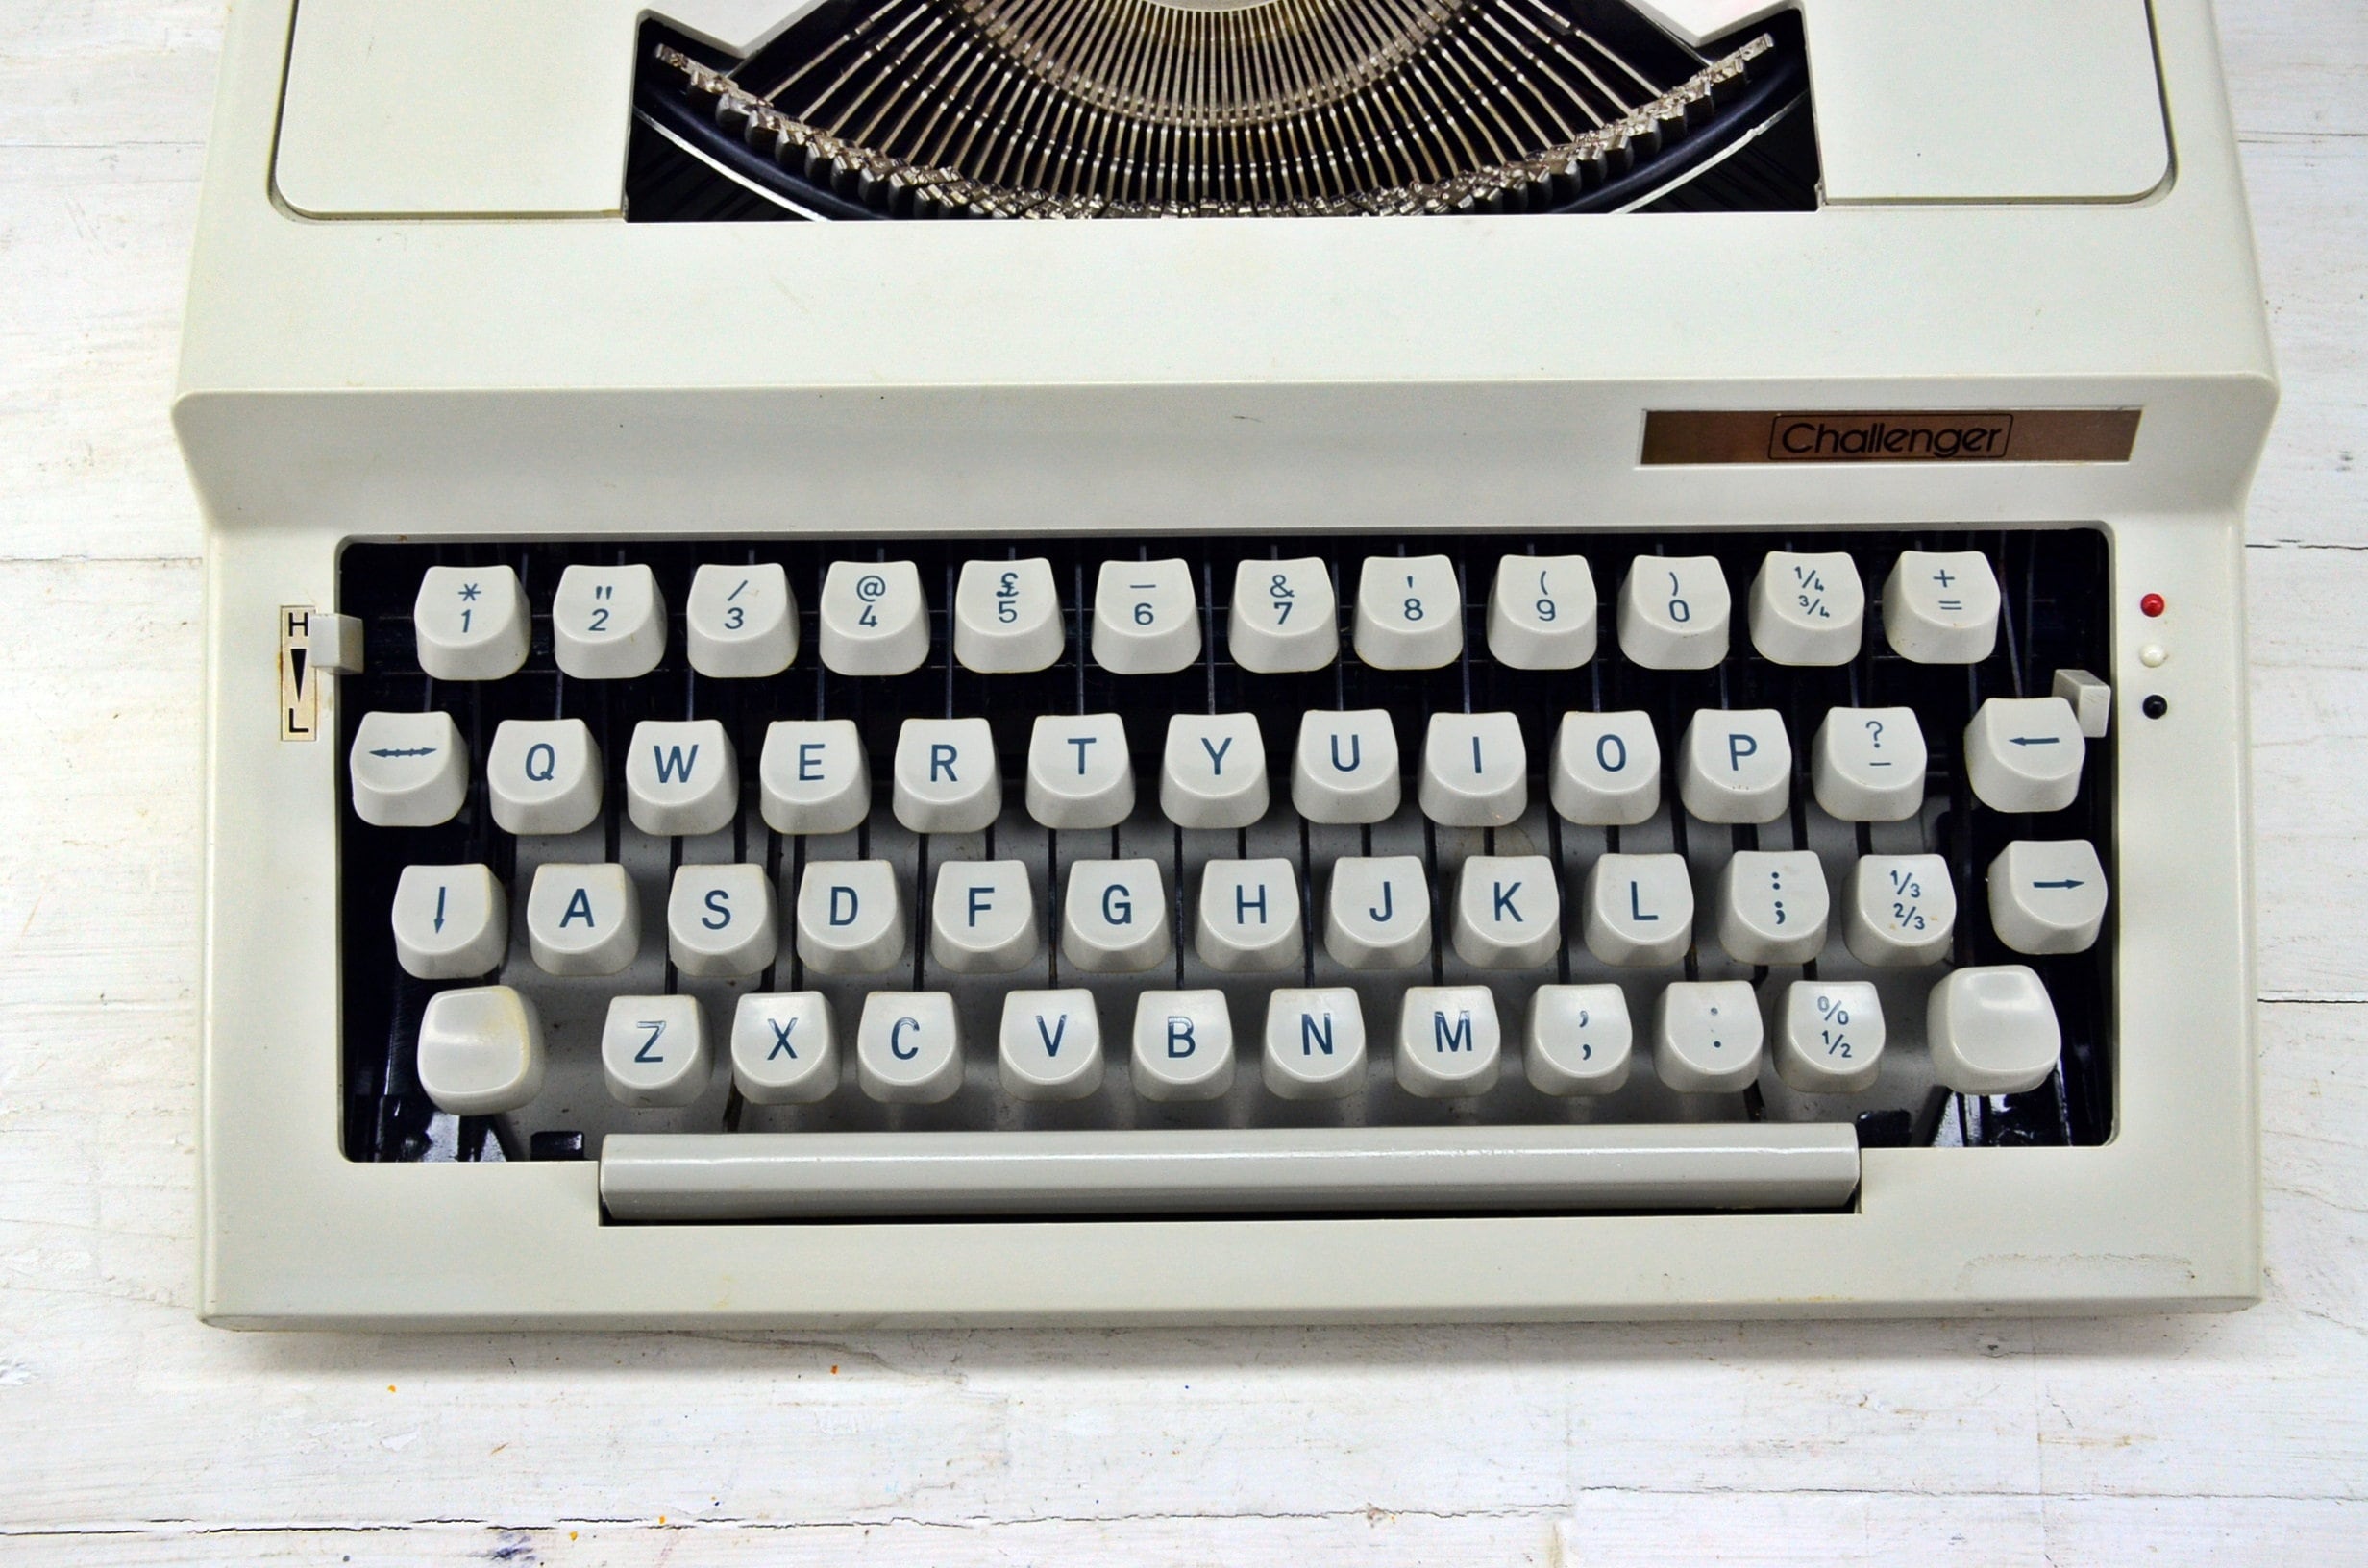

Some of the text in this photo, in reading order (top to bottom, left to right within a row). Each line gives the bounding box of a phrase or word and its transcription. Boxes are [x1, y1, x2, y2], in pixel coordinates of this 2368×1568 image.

[1782, 423, 2002, 457] Challenger
[288, 612, 308, 637] H
[461, 609, 471, 633] 1
[588, 609, 608, 631] 2
[725, 607, 743, 629] 3
[859, 605, 877, 627] 4
[999, 600, 1017, 623] 5
[1135, 603, 1153, 625] 6
[1274, 602, 1292, 625] 7
[1404, 599, 1423, 621] 8
[1537, 600, 1555, 621] 9
[1669, 600, 1690, 622] 0
[289, 708, 308, 733] L
[526, 744, 555, 781] Q
[654, 745, 698, 783] W
[799, 744, 825, 781] E
[931, 745, 957, 782] R
[1068, 738, 1097, 775] T
[1201, 738, 1232, 775] Y
[1331, 735, 1360, 772] U
[1473, 737, 1482, 773] I
[1597, 734, 1626, 772] O
[1729, 734, 1757, 771] P
[559, 889, 594, 927] A
[702, 890, 730, 929] S
[830, 887, 858, 925] D
[969, 887, 994, 927] F
[1102, 884, 1131, 925] G
[1237, 885, 1266, 924] H
[1369, 882, 1392, 921] J
[1494, 882, 1522, 922] K
[1631, 881, 1658, 920] L
[634, 1021, 667, 1063] Z
[767, 1018, 798, 1060] X
[891, 1018, 919, 1060] C
[1037, 1015, 1066, 1057] V
[1168, 1017, 1196, 1058] B
[1302, 1014, 1333, 1055] N
[1435, 1012, 1472, 1052] M
